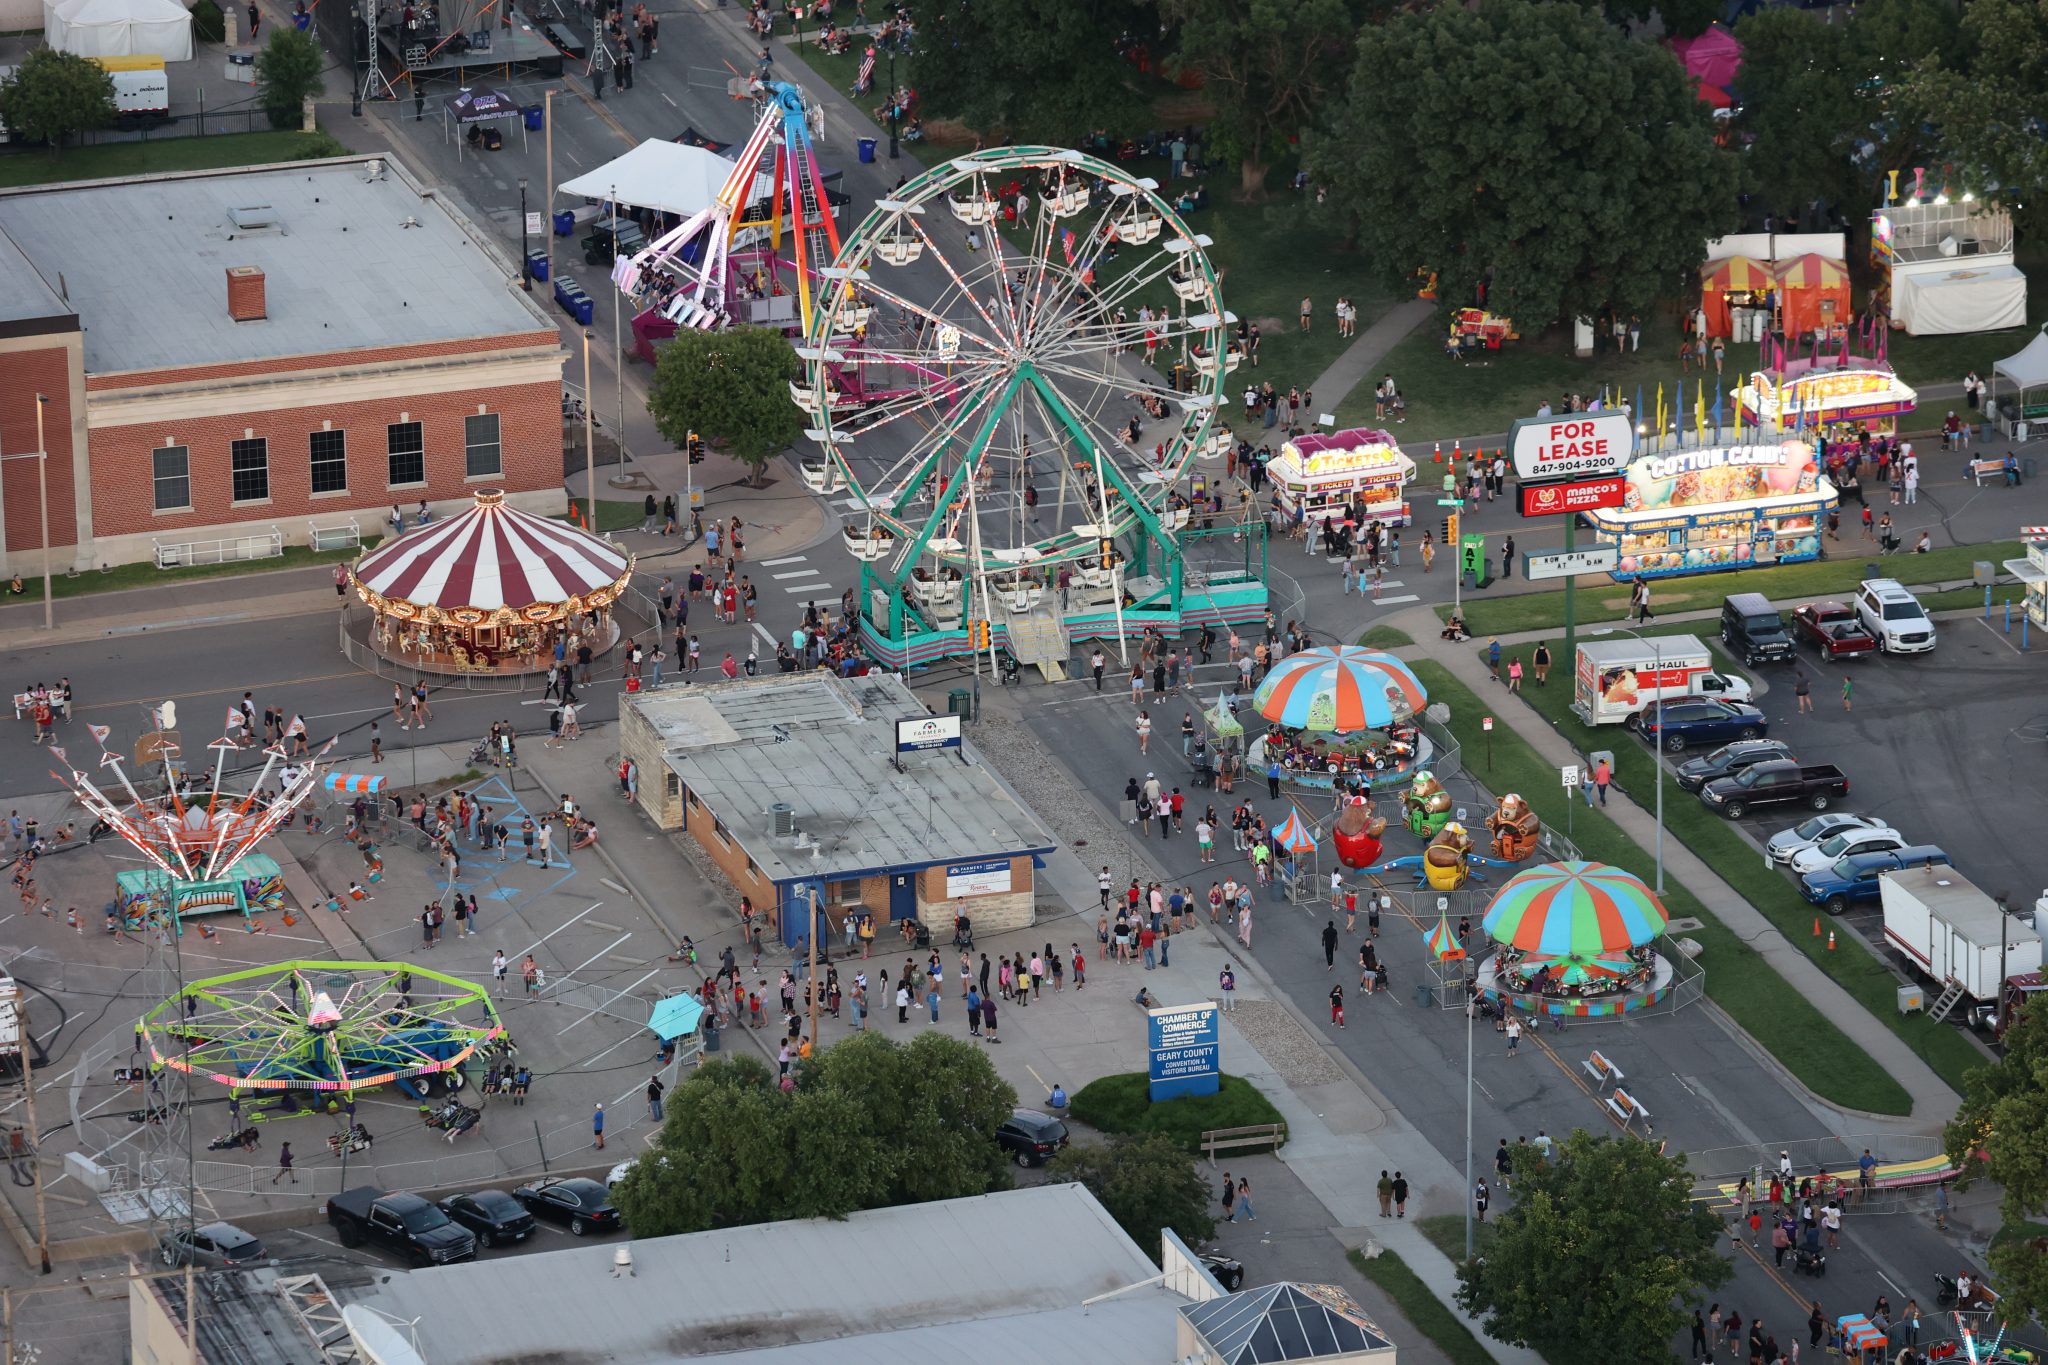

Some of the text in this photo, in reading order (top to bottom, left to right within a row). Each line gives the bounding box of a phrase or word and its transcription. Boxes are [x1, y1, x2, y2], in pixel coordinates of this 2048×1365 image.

[1550, 422, 1595, 441] FOR
[1538, 439, 1608, 462] LEASE
[1728, 445, 1789, 466] CANDY
[1532, 457, 1615, 474] 847-904-9200
[1651, 448, 1723, 479] COTTON
[1321, 480, 1353, 491] TICKETS
[1369, 474, 1402, 484] TICKETS
[1566, 483, 1618, 498] MARCO'S
[1766, 506, 1792, 515] CHEESE
[913, 728, 947, 736] FARMERS
[1564, 775, 1577, 784] 20
[1157, 1011, 1212, 1025] CHAMBER OF
[1162, 1020, 1207, 1033] COMMERCE
[1157, 1047, 1214, 1062] GEARY COUNTY
[1162, 1064, 1210, 1076] VISITORS BUREAU
[1165, 1059, 1201, 1069] CONVENTION
